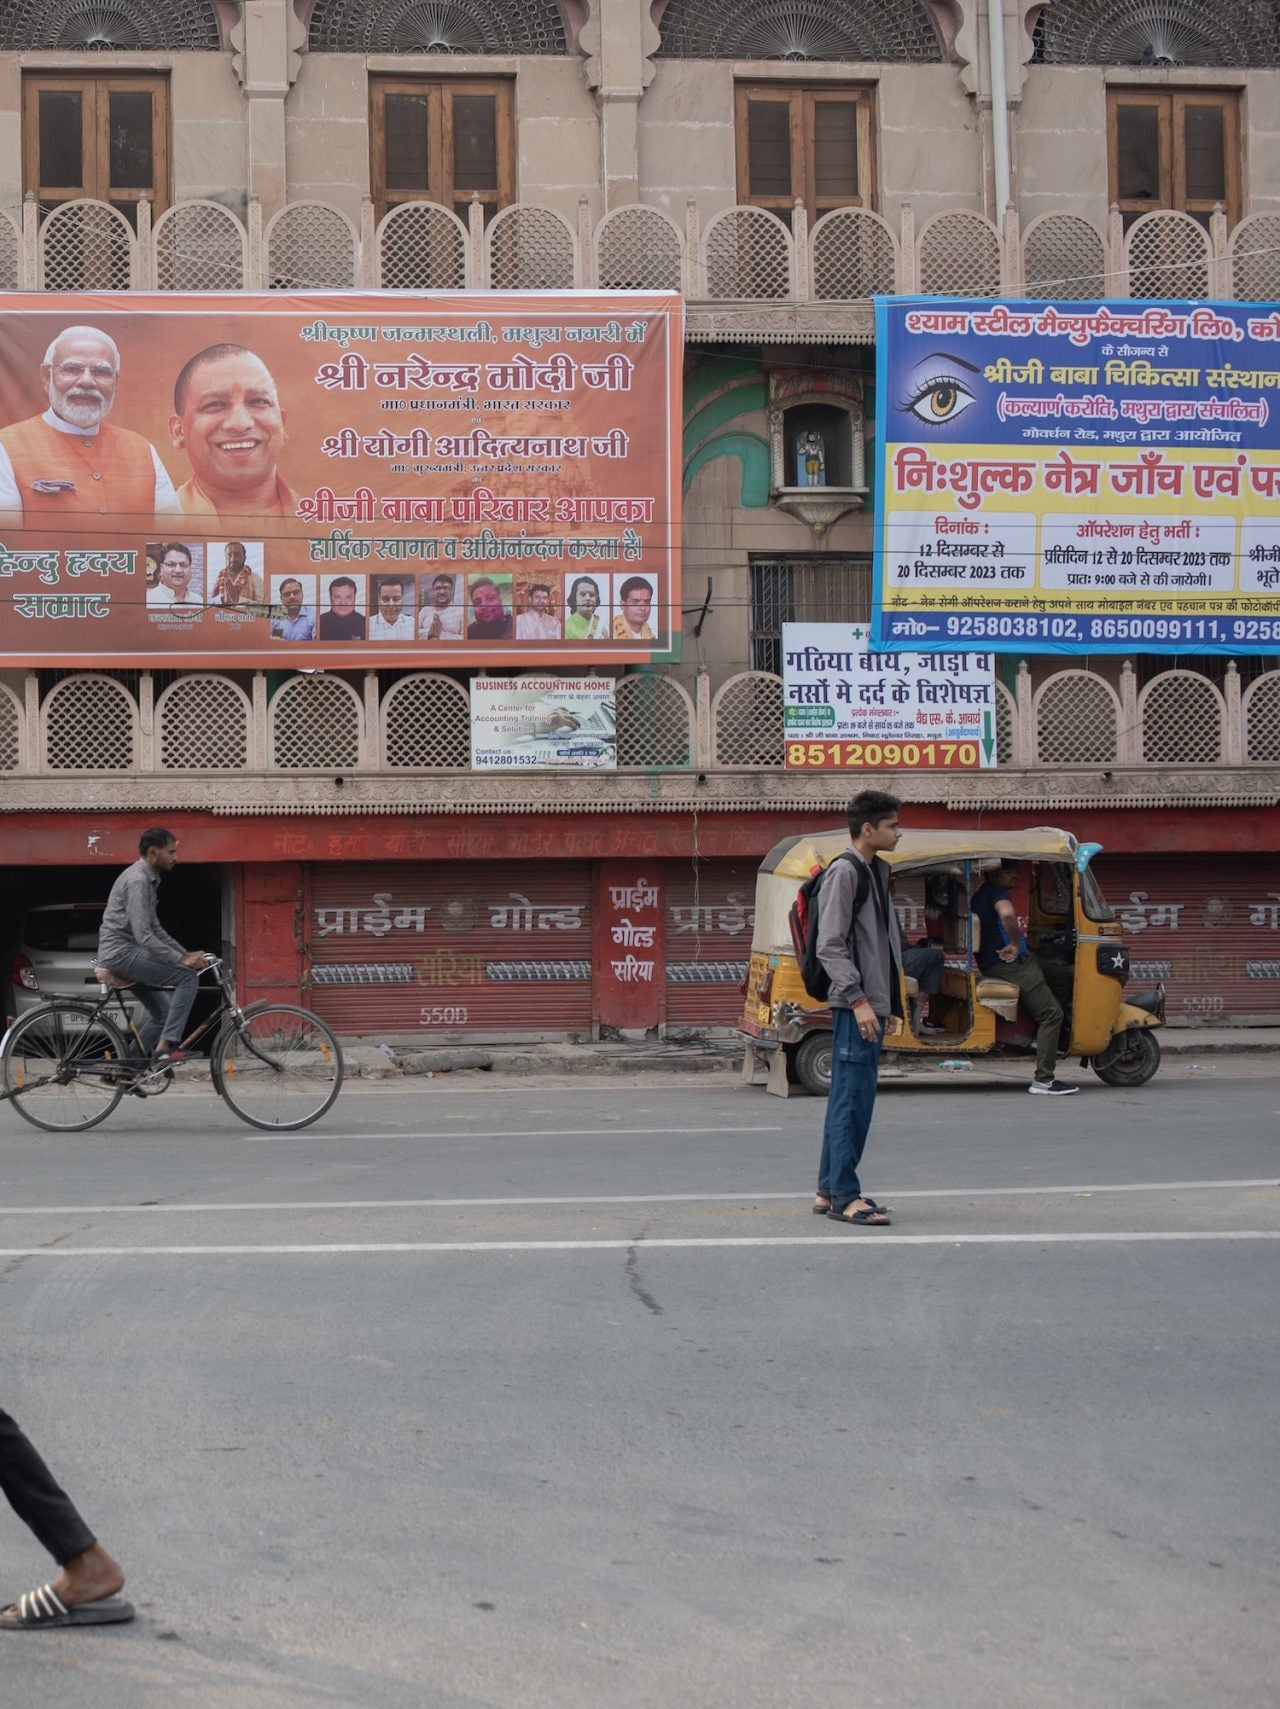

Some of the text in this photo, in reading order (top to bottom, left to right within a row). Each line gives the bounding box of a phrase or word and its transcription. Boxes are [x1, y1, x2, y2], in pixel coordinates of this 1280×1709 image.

[299, 320, 648, 348] श्रीकृष्ण जन्मस्थली, मथुरा नगरी में
[905, 310, 968, 336] श्याम
[973, 309, 1031, 337] स्टील
[1037, 306, 1188, 346] मैन्युफैक्चरिंग
[1102, 345, 1114, 357] के
[1158, 345, 1170, 358] से
[315, 352, 634, 392] श्री नरेन्द्र मोदी जी
[983, 357, 1044, 384] श्रीजी
[1049, 367, 1099, 385] बाबा
[1104, 360, 1200, 387] चिकित्सा
[483, 399, 519, 411] भारत
[523, 399, 571, 411] सरकार
[1122, 401, 1163, 424] मथुरा
[1165, 401, 1195, 421] द्वारा
[1198, 395, 1269, 428] संचालित)
[321, 428, 628, 459] श्री योगी आदित्यनाथ जी
[1022, 429, 1242, 444] गोवर्धन रोड, मथुरा द्वारा आयोजित
[1044, 450, 1101, 495] नेत्र
[1110, 450, 1184, 496] जाँच
[1193, 454, 1248, 498] एवं
[295, 486, 654, 523] श्रीजी बाबा परिवार आपका
[935, 516, 980, 535] दिनांक
[1076, 520, 1192, 545] ऑपरेशन हेतु भर्ती
[308, 528, 371, 561] हार्दिक
[375, 536, 440, 561] स्वागत
[444, 536, 458, 560] व
[567, 535, 620, 560] करता
[920, 539, 1005, 558] 12 दिसम्बर से
[1044, 545, 1231, 567] प्रतिदिन 12 से 20 दिसम्बर 2023 तक
[65, 550, 137, 577] हृदय
[897, 560, 1026, 579] 20 दिसम्बर 2023 तक
[1095, 574, 1116, 586] 9:00
[1118, 571, 1137, 586] बजे
[1140, 573, 1150, 586] से
[1153, 571, 1169, 586] की
[1049, 596, 1072, 610] अपने
[1176, 599, 1206, 611] पहचान
[946, 616, 1083, 642] 9258038102,
[1090, 618, 1226, 642] 8650099111,
[786, 647, 853, 672] गठिया
[476, 680, 610, 691] BUSINESS ACCOUNTING HOME
[789, 678, 830, 704] नसों
[858, 678, 886, 705] दर्द
[891, 679, 911, 704] के
[916, 678, 991, 704] विशेषज्ञ
[475, 715, 551, 724] Accounting Training
[958, 708, 981, 725] आचार्य
[476, 755, 537, 765] 9412801532
[788, 743, 977, 767] 8512090170
[608, 877, 659, 912] प्राईम
[314, 893, 587, 936] प्राईम गोल्ड
[611, 919, 656, 948] गोल्ड
[610, 954, 655, 983] सरिया
[419, 1007, 468, 1025] 550D
